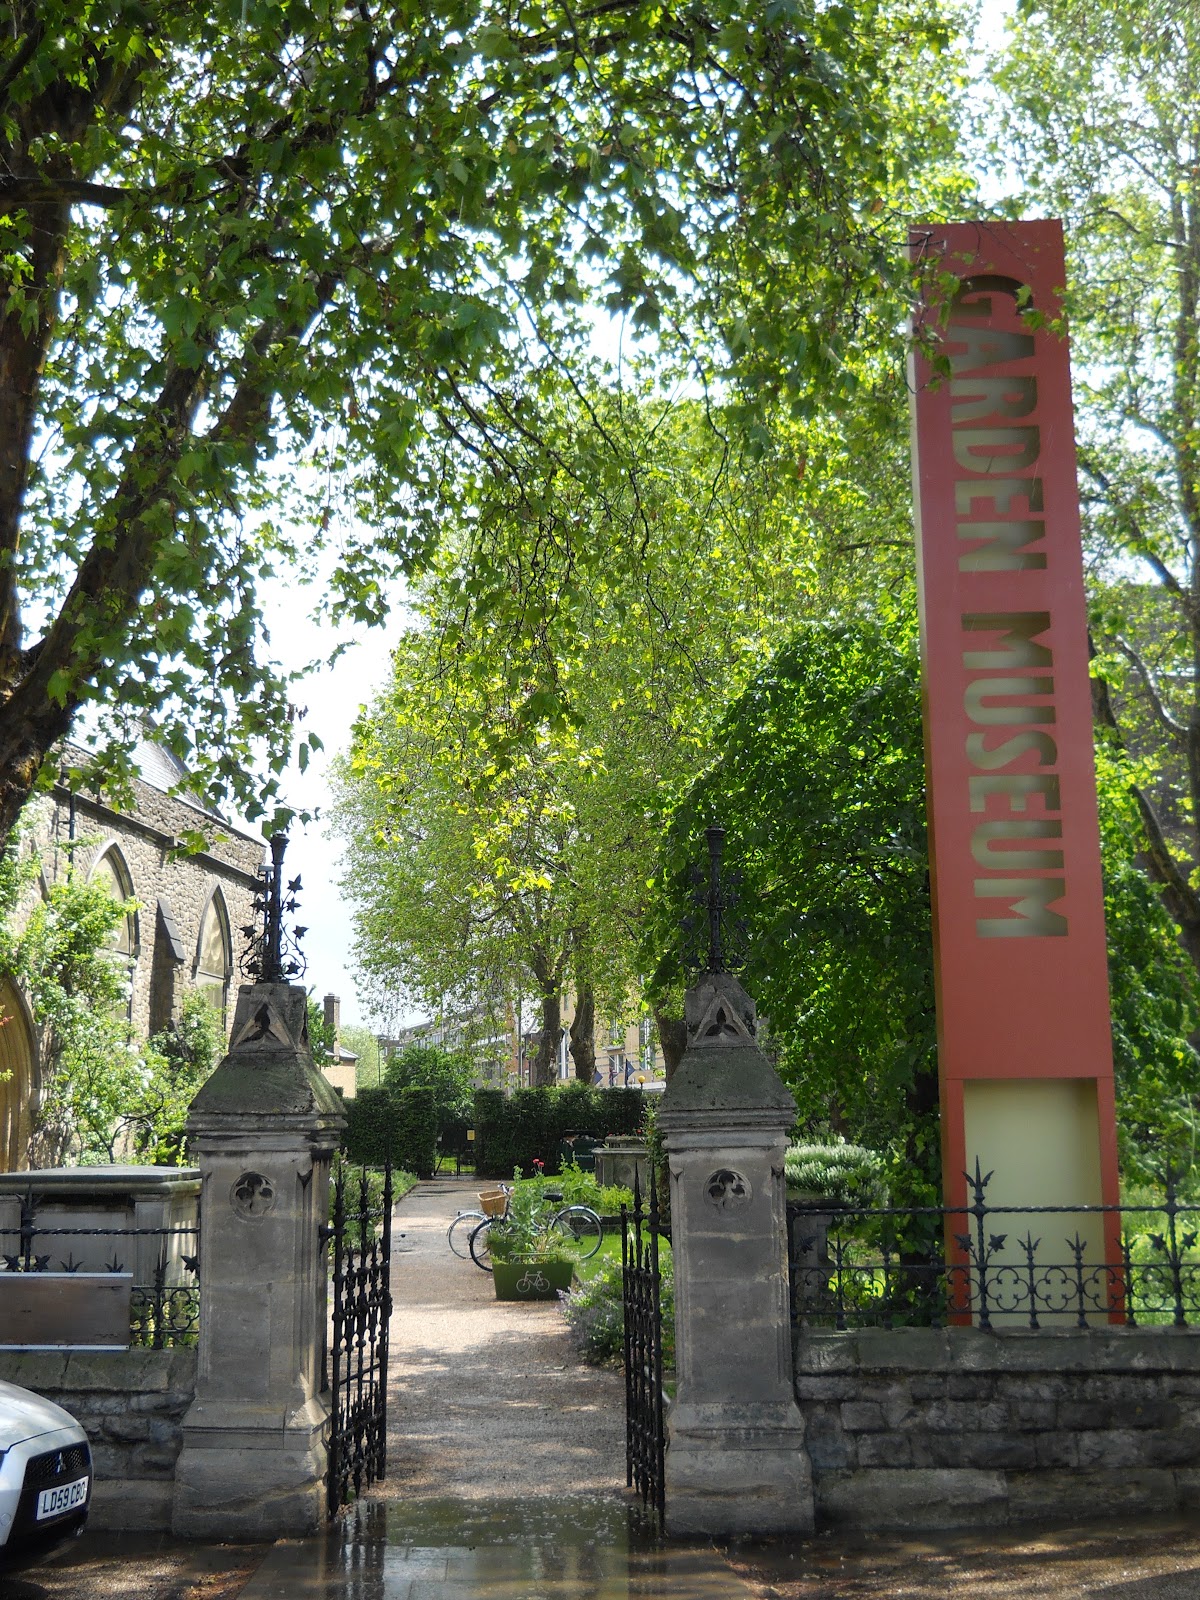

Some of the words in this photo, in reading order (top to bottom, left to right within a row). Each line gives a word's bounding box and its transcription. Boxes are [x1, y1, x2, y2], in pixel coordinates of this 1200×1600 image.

[948, 274, 1047, 572] GARDEN
[961, 611, 1069, 938] MUSEUM
[43, 1488, 70, 1513] LD59
